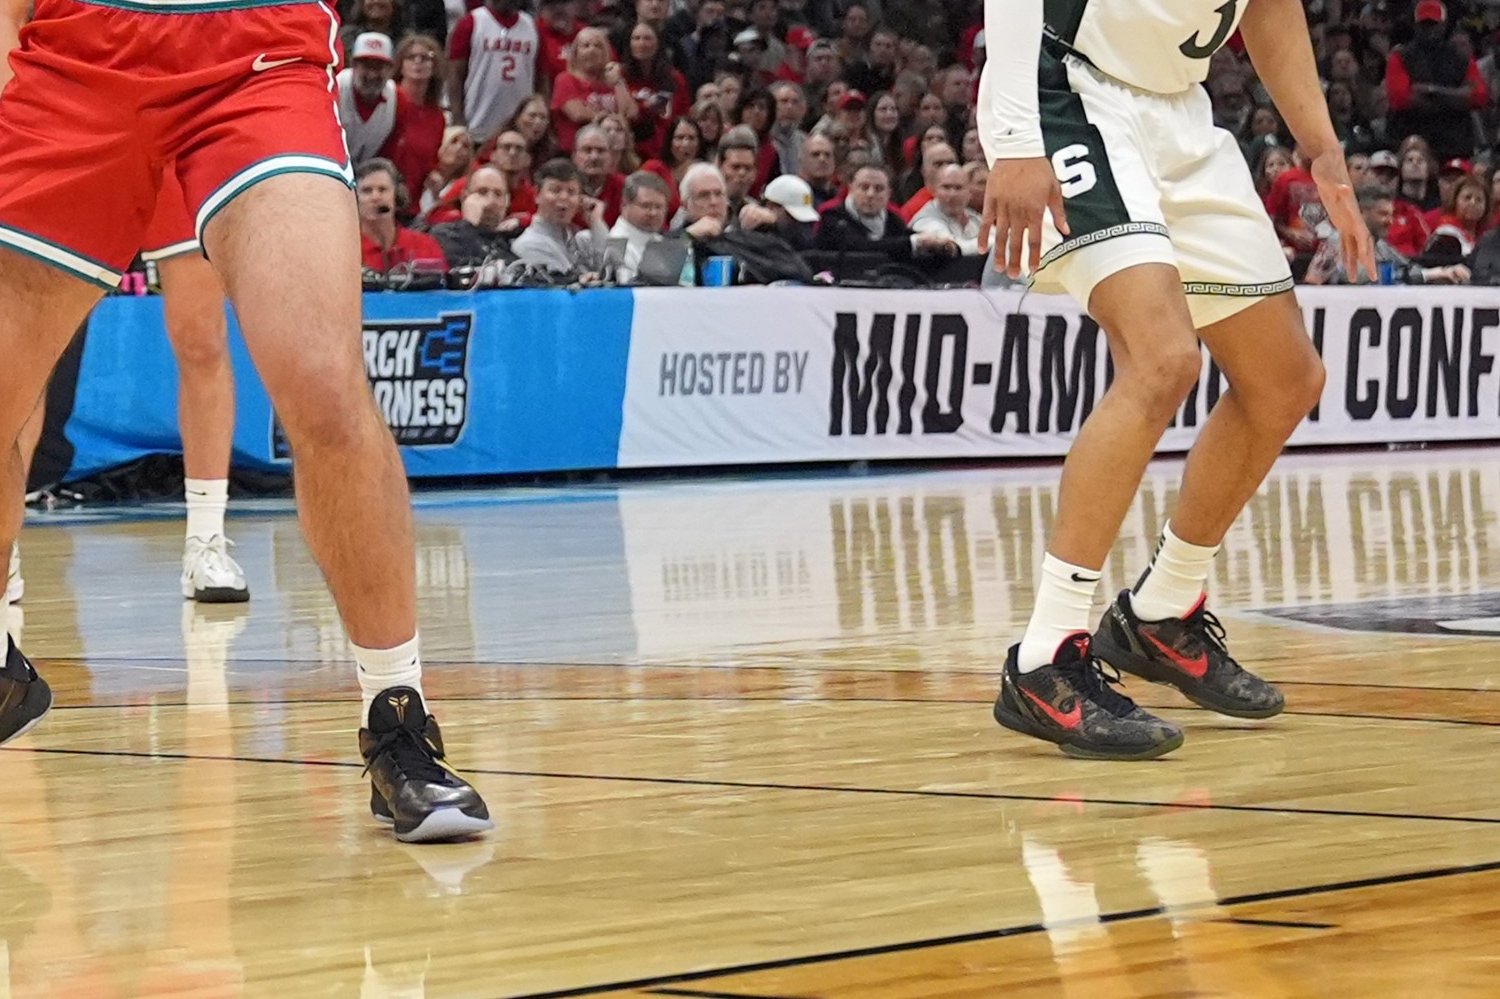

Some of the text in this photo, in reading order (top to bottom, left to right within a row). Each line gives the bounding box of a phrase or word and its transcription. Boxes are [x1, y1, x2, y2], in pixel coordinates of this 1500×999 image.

[1051, 143, 1097, 199] S
[658, 351, 764, 397] HOSTED
[772, 350, 809, 395] BY
